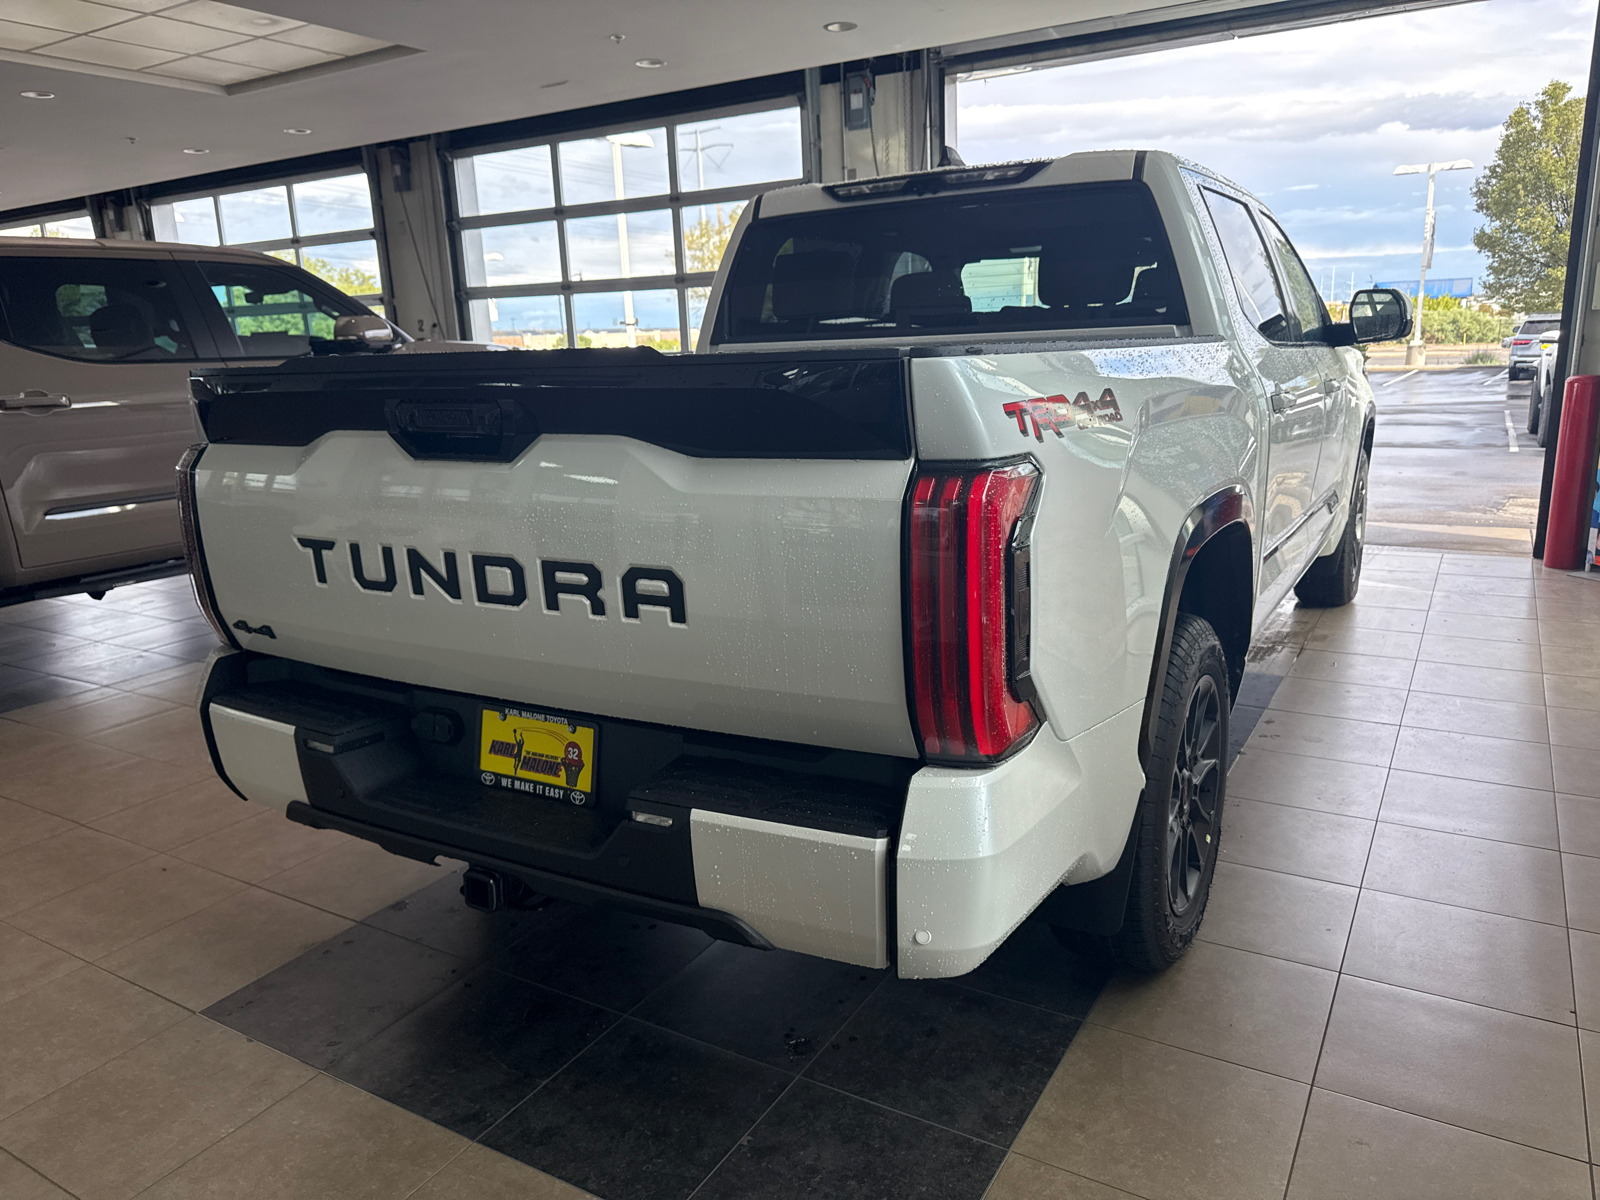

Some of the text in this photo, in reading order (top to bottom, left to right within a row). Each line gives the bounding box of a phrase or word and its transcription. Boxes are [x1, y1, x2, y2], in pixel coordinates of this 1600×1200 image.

[417, 319, 425, 332] 2
[1002, 394, 1076, 443] TRD
[1072, 388, 1120, 416] 4x4
[293, 535, 688, 628] TUNDRA
[505, 708, 568, 725] KARL MALONE TOYOTA
[488, 739, 517, 758] KARL
[567, 747, 579, 760] 32
[520, 756, 562, 778] MALONE
[501, 777, 564, 799] WE MAKE IT EASY
